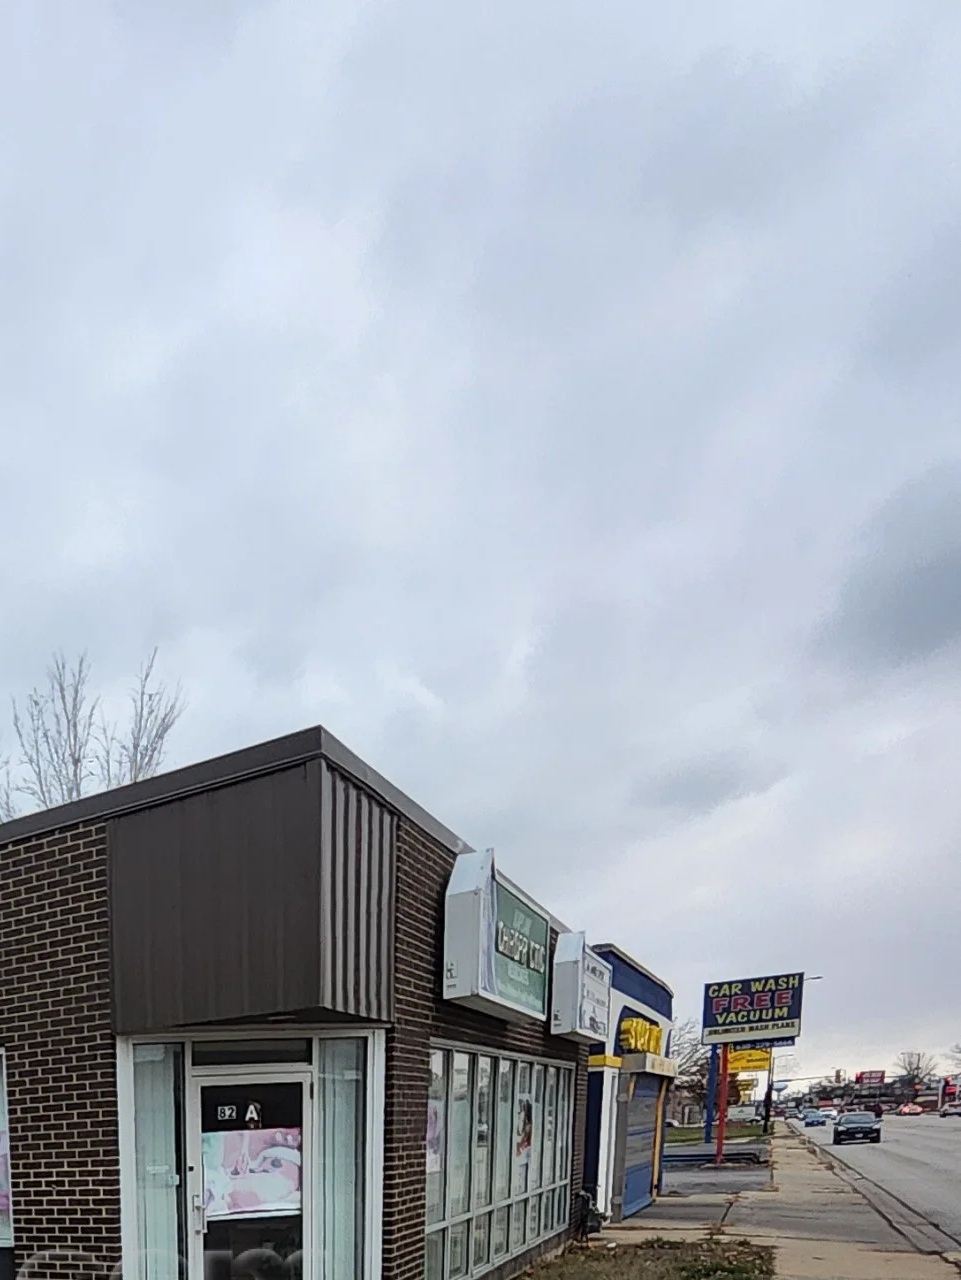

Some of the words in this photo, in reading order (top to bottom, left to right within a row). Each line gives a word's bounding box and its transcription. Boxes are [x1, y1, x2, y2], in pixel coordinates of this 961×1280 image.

[708, 982, 742, 998] CAR
[750, 975, 800, 992] WASH
[712, 990, 793, 1014] FREE
[716, 1008, 788, 1024] VACUUM
[748, 1023, 769, 1032] WASH
[771, 1021, 795, 1030] PLANS
[218, 1106, 236, 1119] 82
[245, 1104, 258, 1121] A
